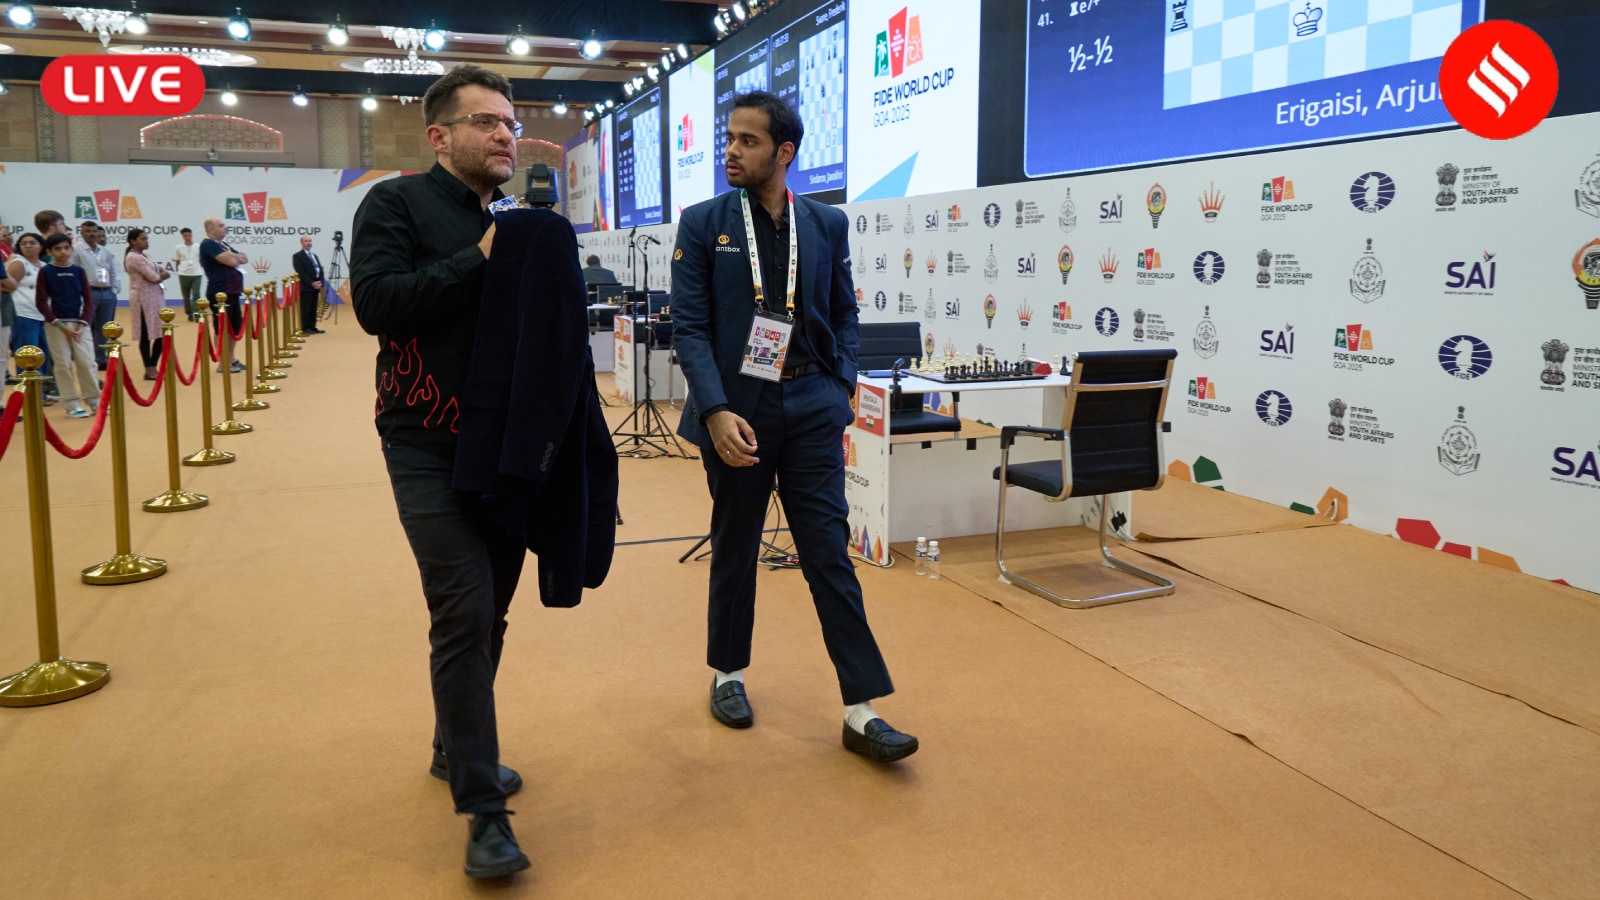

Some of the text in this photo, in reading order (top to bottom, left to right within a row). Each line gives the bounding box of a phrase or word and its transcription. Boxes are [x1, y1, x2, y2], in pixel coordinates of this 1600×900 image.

[1037, 12, 1054, 28] 41.
[874, 67, 954, 108] FIDE WORLD CUP
[1276, 79, 1443, 127] Erigaisi, Arju
[874, 104, 910, 128] GOA 2025
[1488, 187, 1519, 196] AFFAIRS
[1479, 196, 1508, 204] SPORTS
[1100, 200, 1122, 219] SAI
[1276, 204, 1298, 212] WORLD
[1300, 204, 1313, 212] CUP
[926, 213, 939, 228] SAI
[6, 226, 24, 235] UP
[105, 226, 178, 235] WOD CUP
[226, 226, 321, 236] FIDE WORLD CUP
[106, 236, 128, 244] 025
[250, 236, 274, 244] 2025
[876, 257, 886, 270] SAI
[1017, 257, 1035, 274] SAI
[1445, 262, 1496, 289] SAI
[946, 302, 960, 316] SAI
[1260, 329, 1294, 354] SAI
[1334, 352, 1395, 366] FIDE WORLD CUP
[1347, 363, 1363, 371] 2025
[1572, 380, 1591, 388] AND
[1188, 400, 1231, 413] FIDE WORLD CUP
[1350, 425, 1394, 438] YOUTH AFFAIRS
[1362, 435, 1385, 444] SPORTS
[1552, 446, 1600, 482] SA
